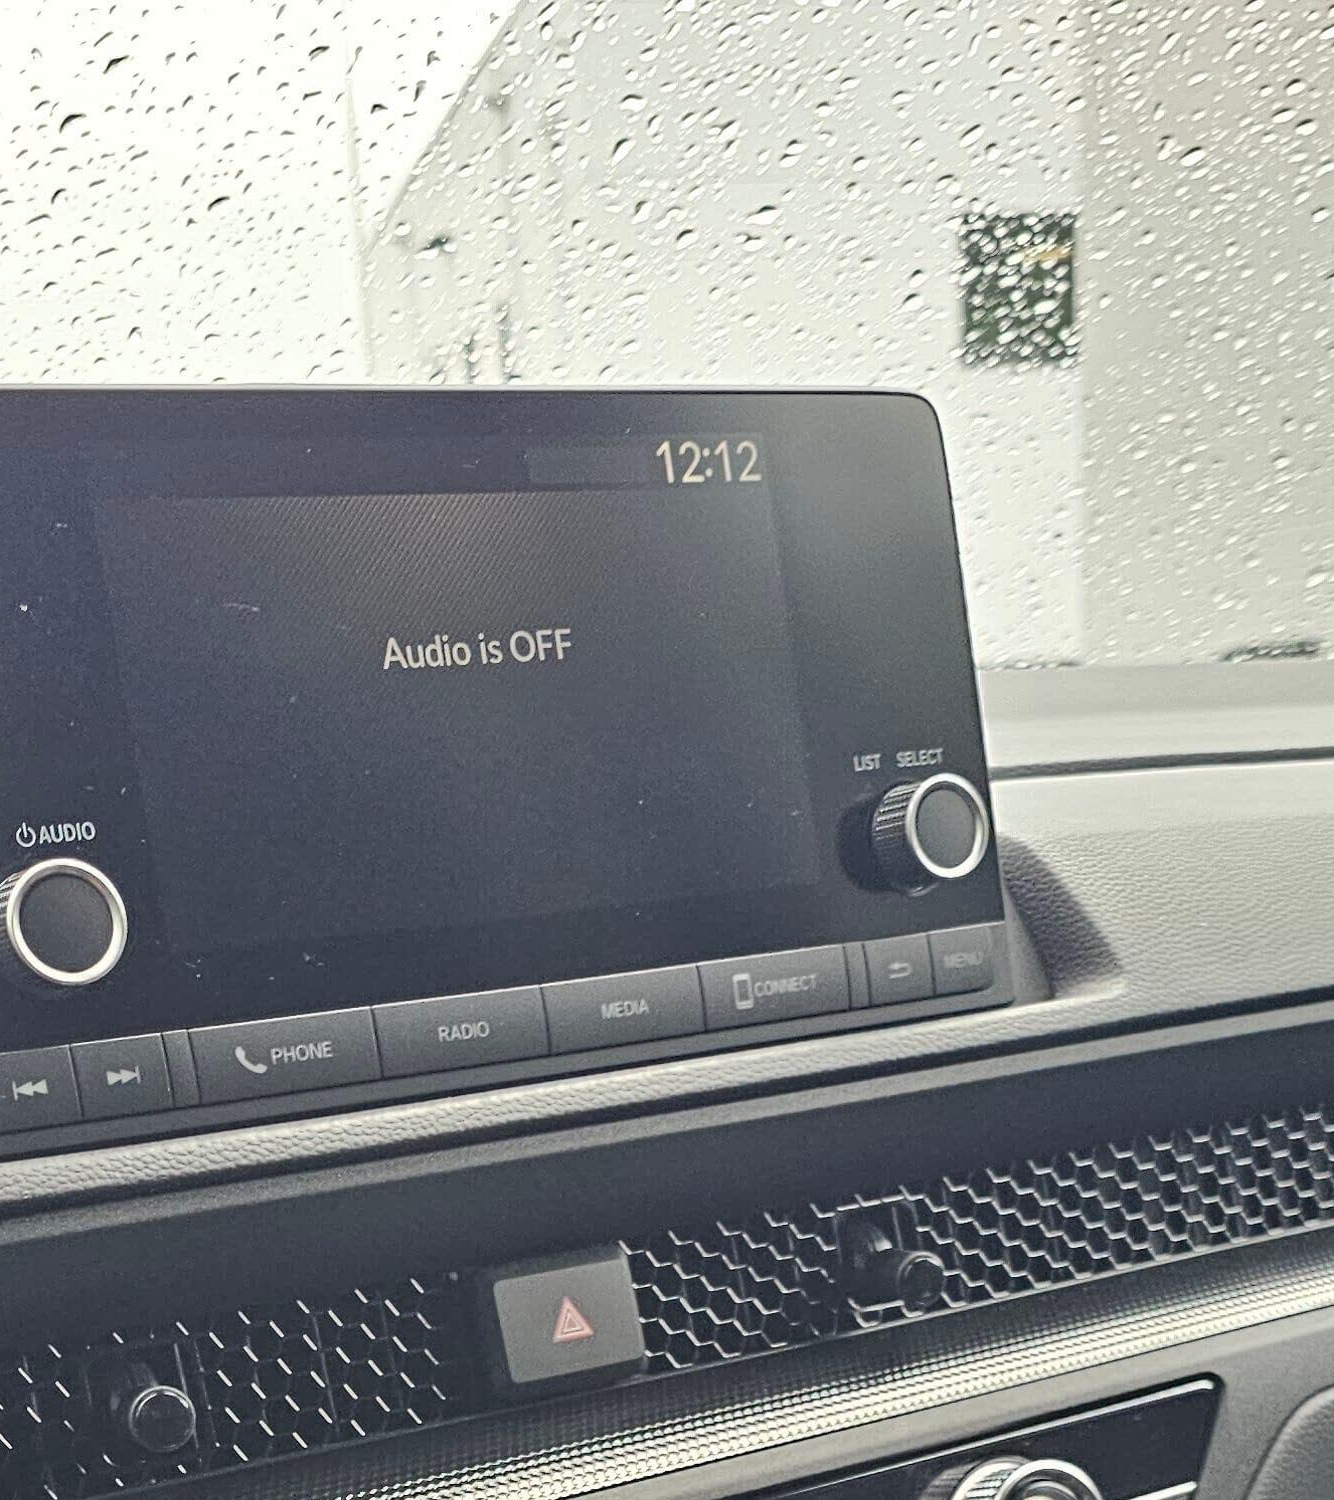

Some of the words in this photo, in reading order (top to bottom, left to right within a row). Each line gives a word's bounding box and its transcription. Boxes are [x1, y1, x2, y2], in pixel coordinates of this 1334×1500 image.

[655, 440, 762, 483] 12:12
[383, 633, 472, 670] Audio
[478, 632, 503, 664] is
[509, 628, 571, 662] OFF
[853, 753, 881, 772] LIST
[896, 748, 943, 768] SELECT
[39, 821, 96, 844] AUDIO
[753, 973, 817, 998] CONNECT
[600, 998, 650, 1020] MEDIA
[438, 1021, 490, 1042] RADIO
[270, 1041, 334, 1066] PHONE
